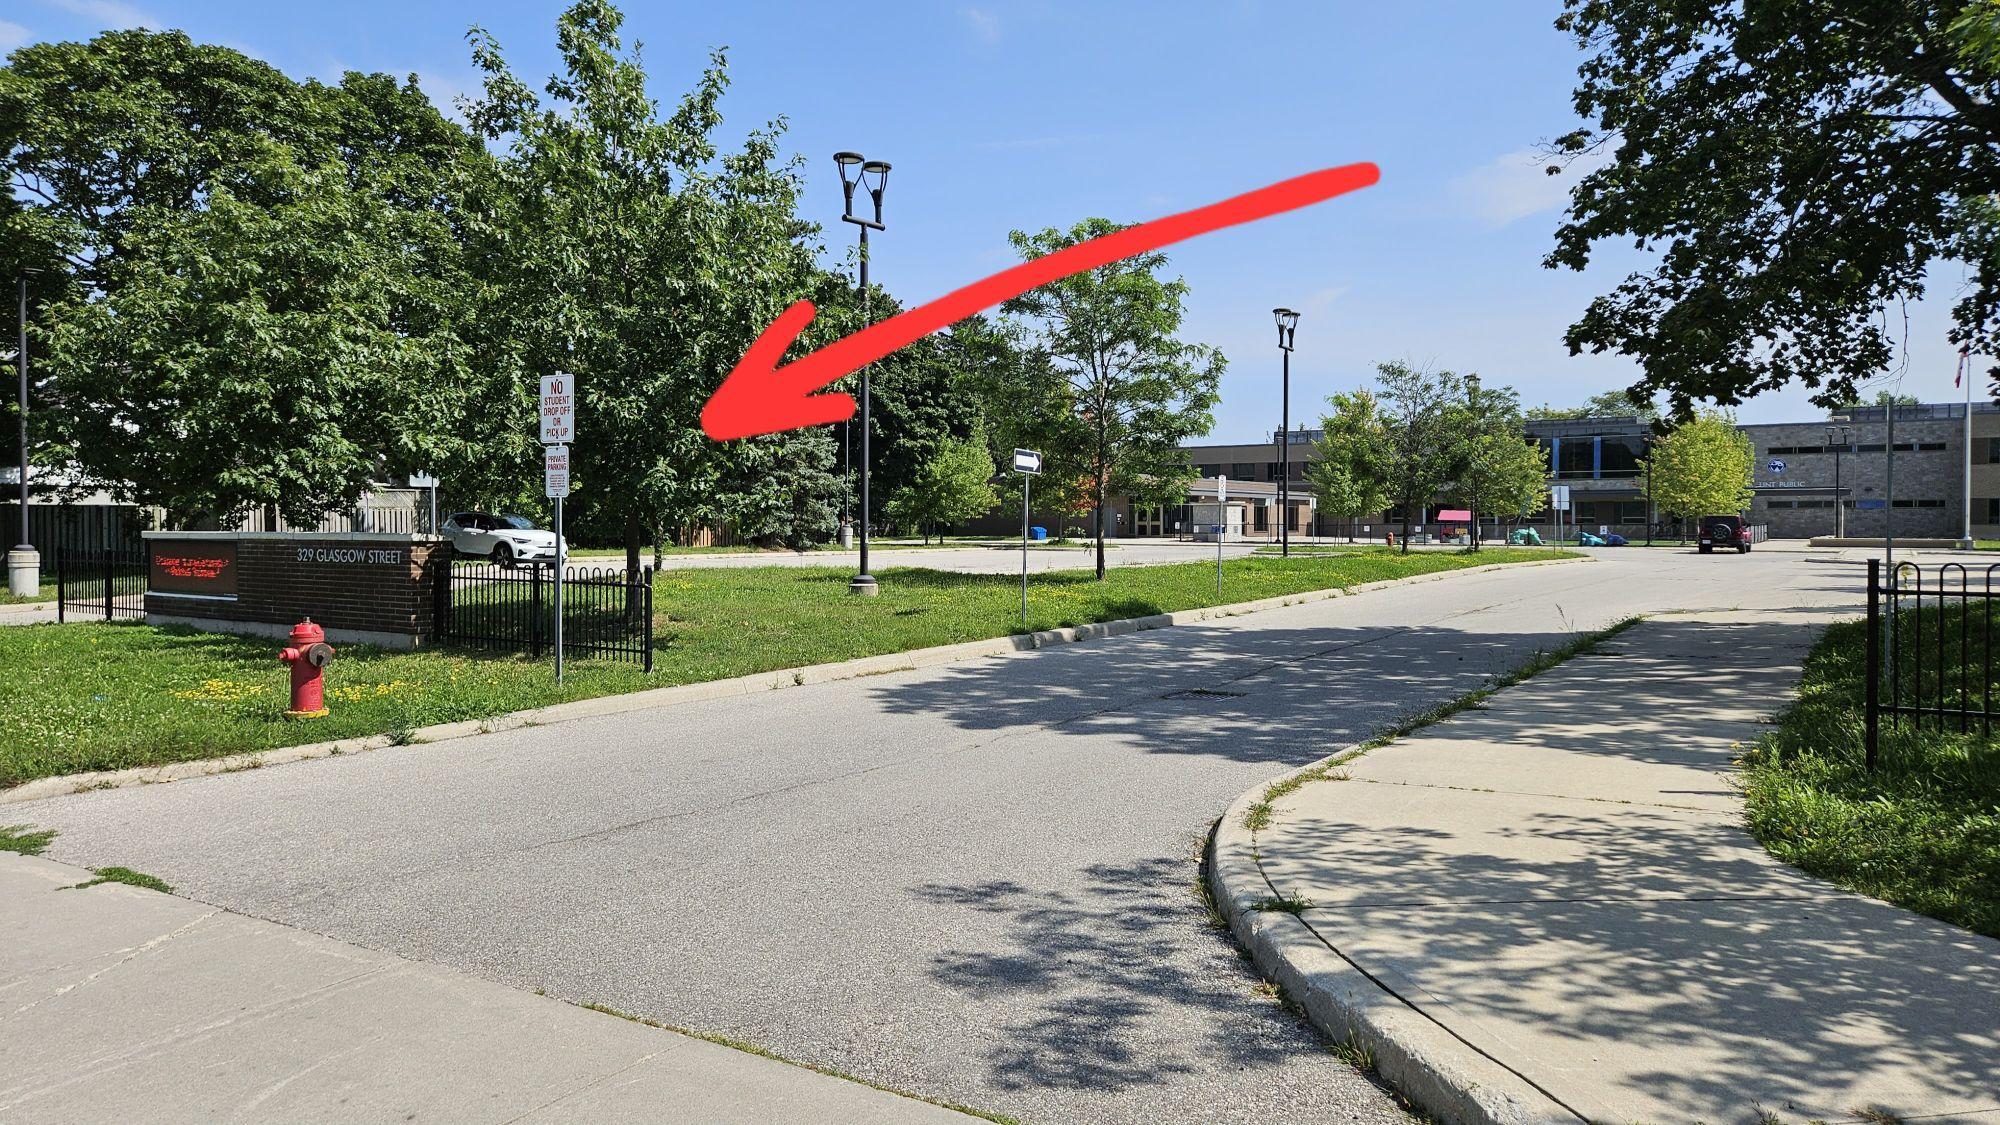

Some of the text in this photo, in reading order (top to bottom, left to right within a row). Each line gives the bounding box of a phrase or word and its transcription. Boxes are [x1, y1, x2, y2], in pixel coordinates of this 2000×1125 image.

[551, 380, 563, 394] NO
[544, 395, 570, 406] STUDENT
[543, 406, 571, 416] DROP OFF
[553, 417, 561, 426] OR
[546, 427, 569, 437] PICK UP
[547, 455, 566, 463] PRIVATE
[297, 548, 402, 564] 329 GLASGOW STREET
